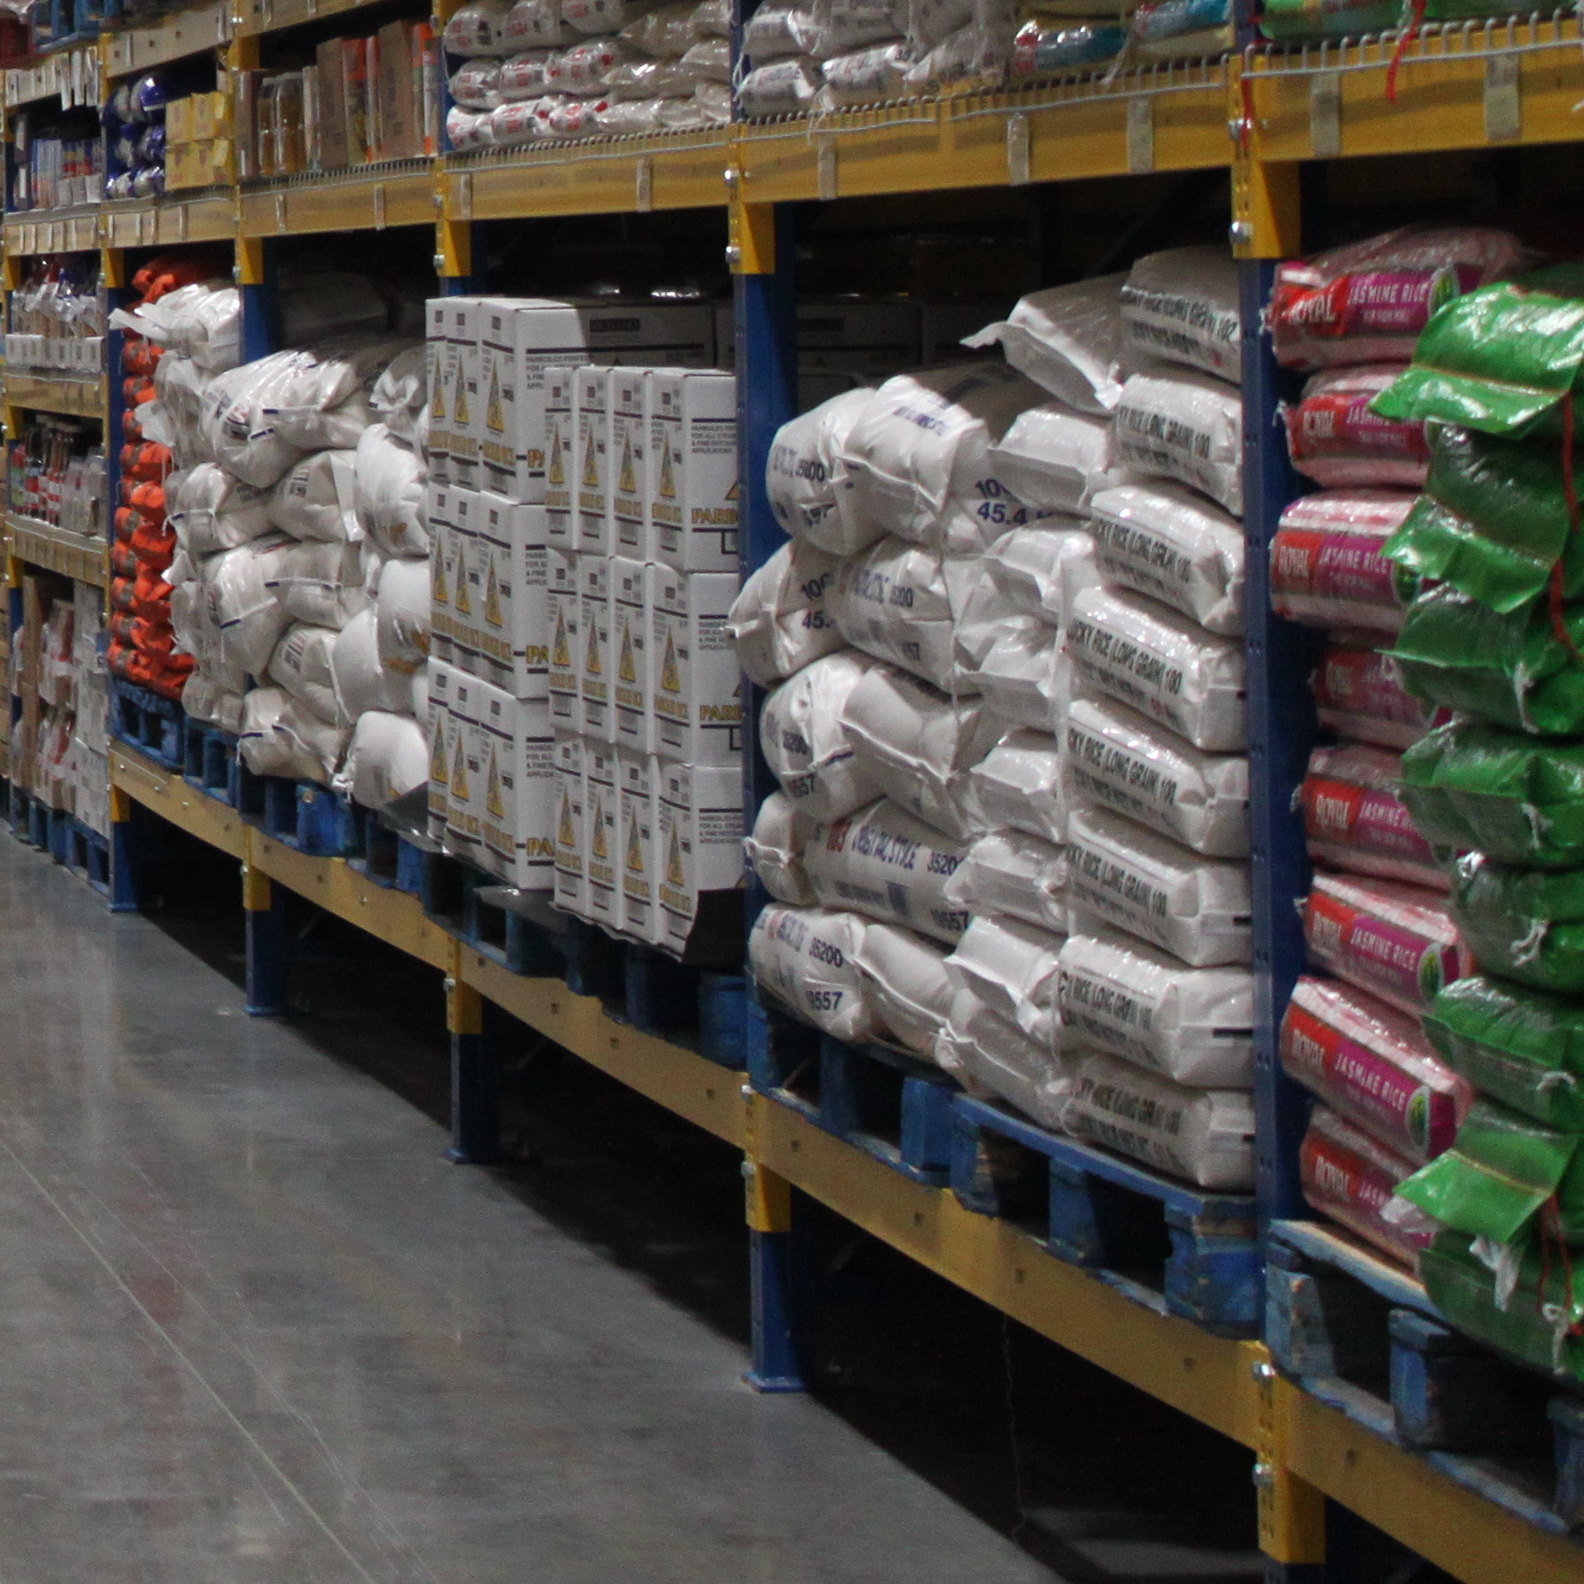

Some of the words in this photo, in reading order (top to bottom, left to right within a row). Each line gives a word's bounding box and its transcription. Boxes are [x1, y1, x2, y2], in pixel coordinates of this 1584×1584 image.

[1348, 282, 1398, 306] JASMINE
[1400, 280, 1430, 305] RICE
[691, 507, 739, 524] PARB
[977, 500, 1027, 526] 45.4
[1318, 545, 1361, 571] JASMINE
[1363, 551, 1388, 576] RICE
[699, 704, 743, 721] PARB
[1350, 926, 1393, 961] JASMINE
[1392, 943, 1417, 972] RICE
[1334, 1052, 1381, 1096] JASMINE
[1382, 1080, 1407, 1112] RICE
